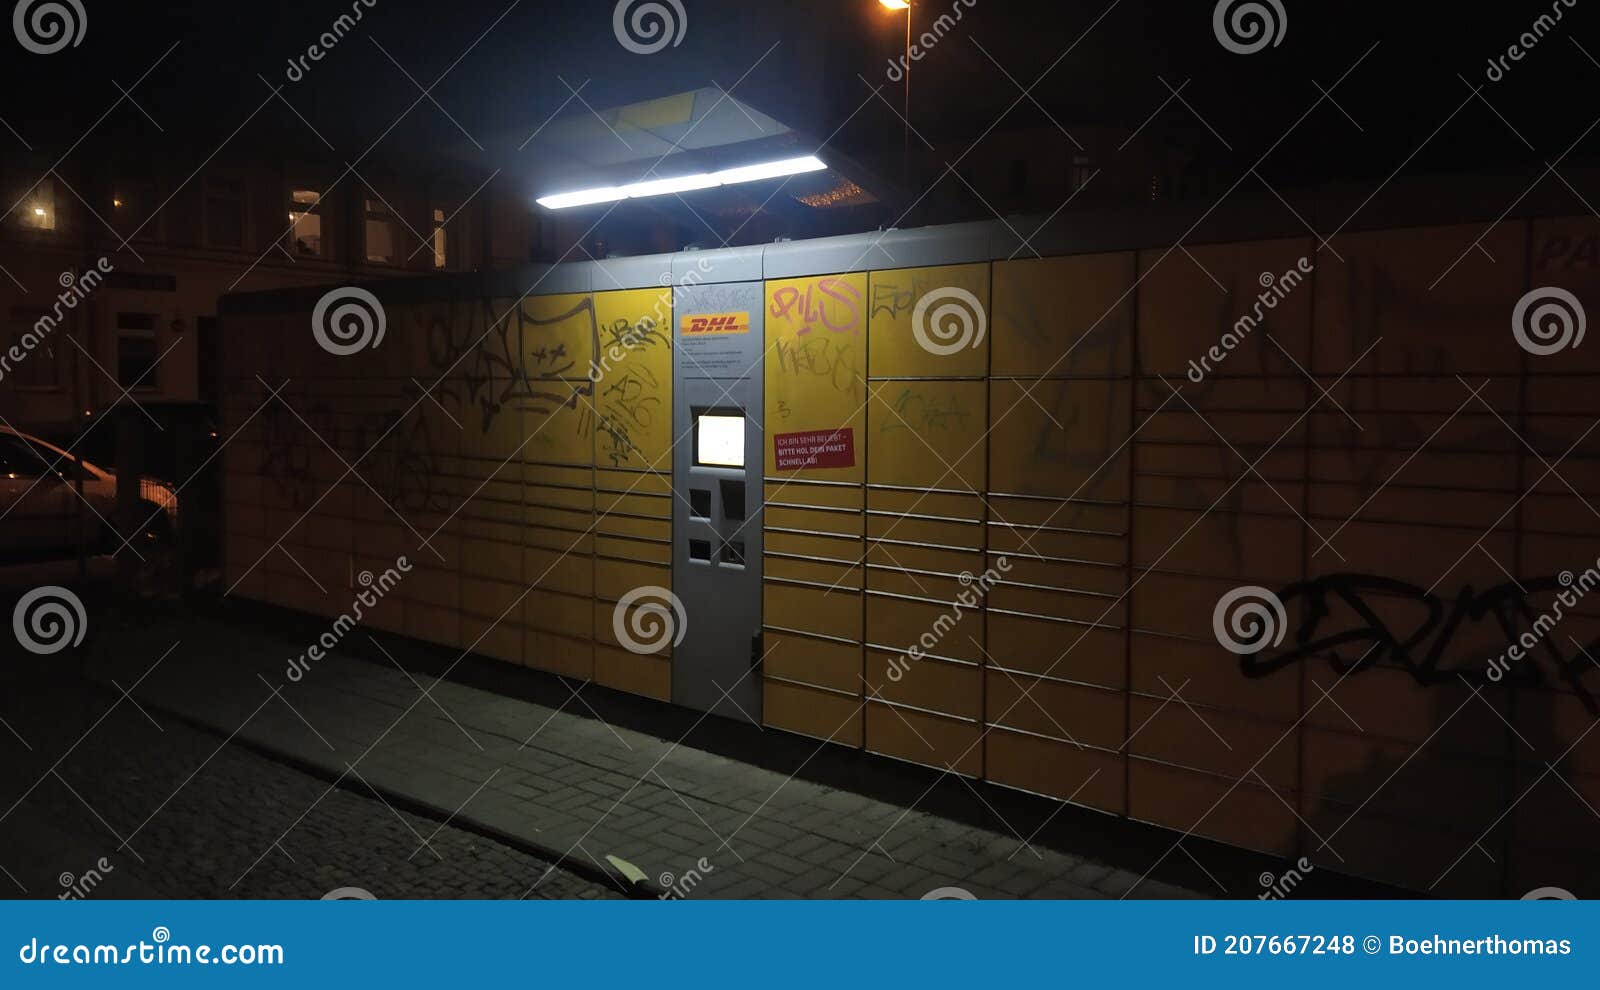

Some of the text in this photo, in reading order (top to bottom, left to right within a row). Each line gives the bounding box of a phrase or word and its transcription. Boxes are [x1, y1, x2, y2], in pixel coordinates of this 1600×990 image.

[690, 316, 739, 333] DHL
[800, 436, 816, 444] SEHR
[816, 434, 841, 442] BELIEBT
[779, 448, 795, 456] BITTE
[826, 445, 846, 453] PAKET
[779, 458, 806, 466] SCHNELL
